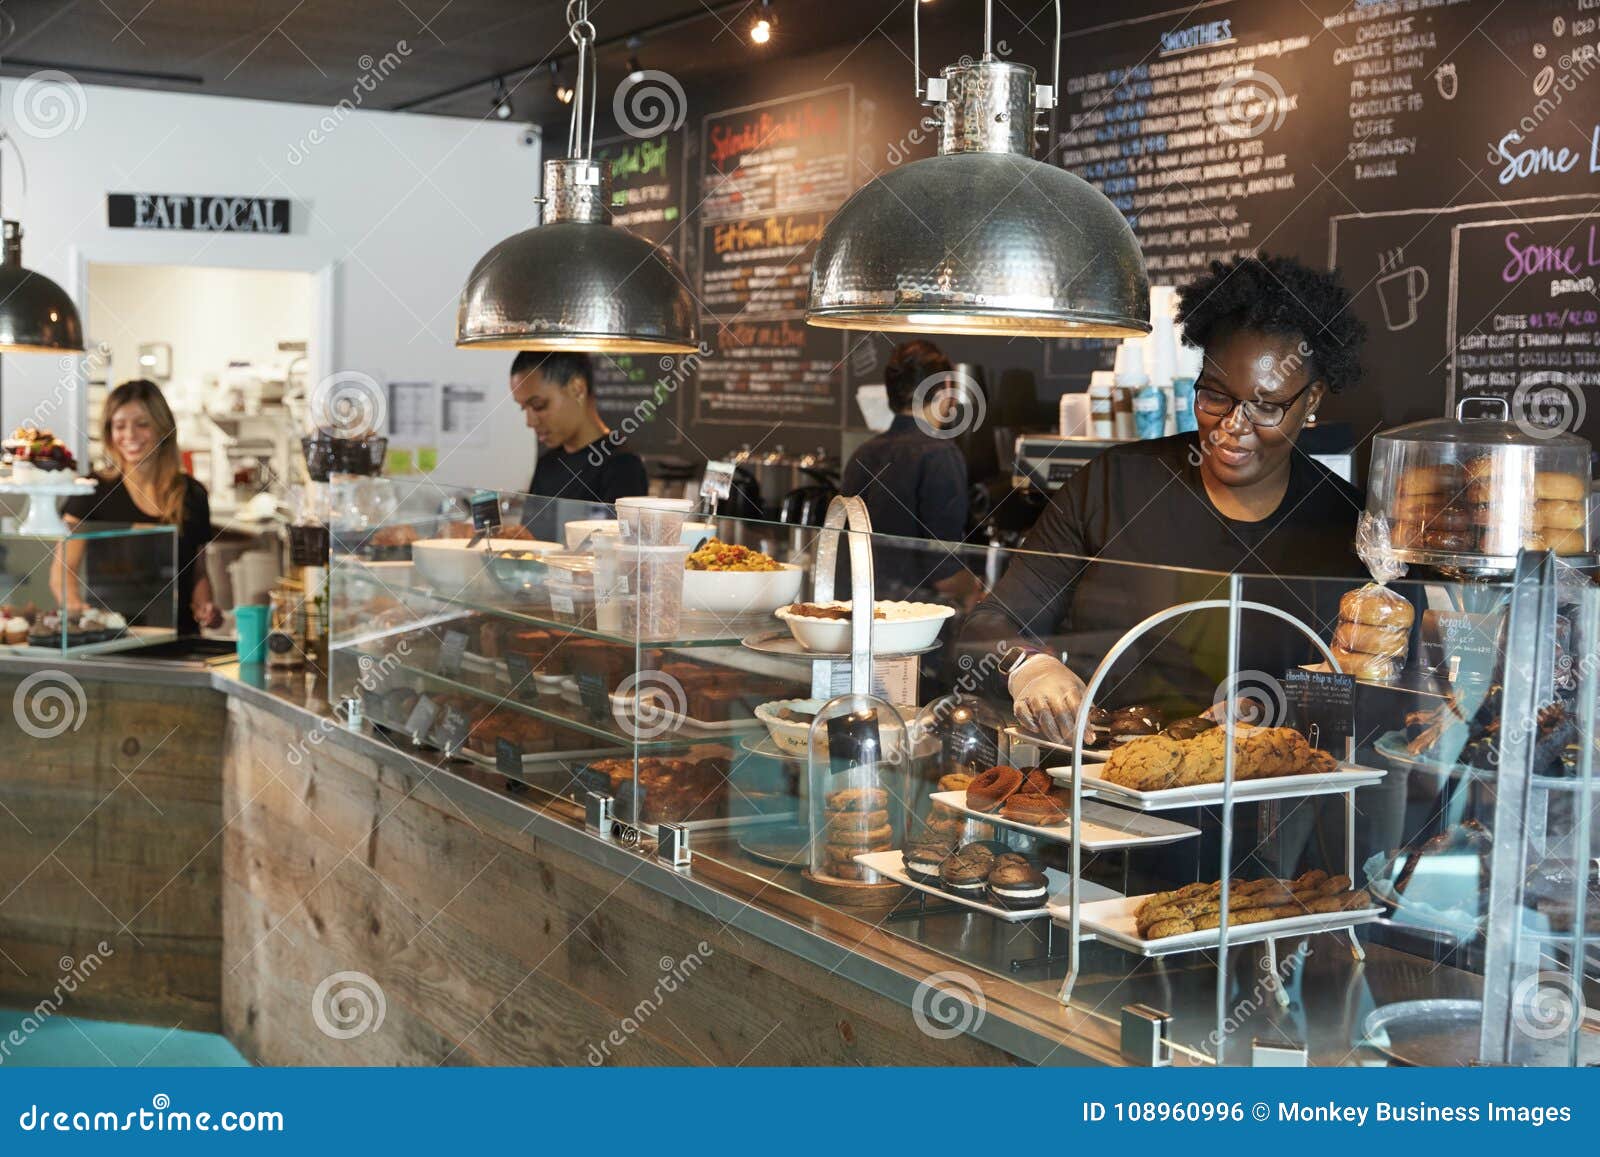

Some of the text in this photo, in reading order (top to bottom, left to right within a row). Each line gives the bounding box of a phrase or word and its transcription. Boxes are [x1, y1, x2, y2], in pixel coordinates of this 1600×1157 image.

[1161, 19, 1233, 51] SMOOTHIES
[1356, 16, 1416, 43] CHOCOLATE
[1353, 118, 1395, 138] COFFEE
[1499, 131, 1580, 186] Some
[135, 195, 283, 233] EAT LOCAL
[1503, 232, 1582, 282] Some
[1494, 314, 1528, 331] COFFEE
